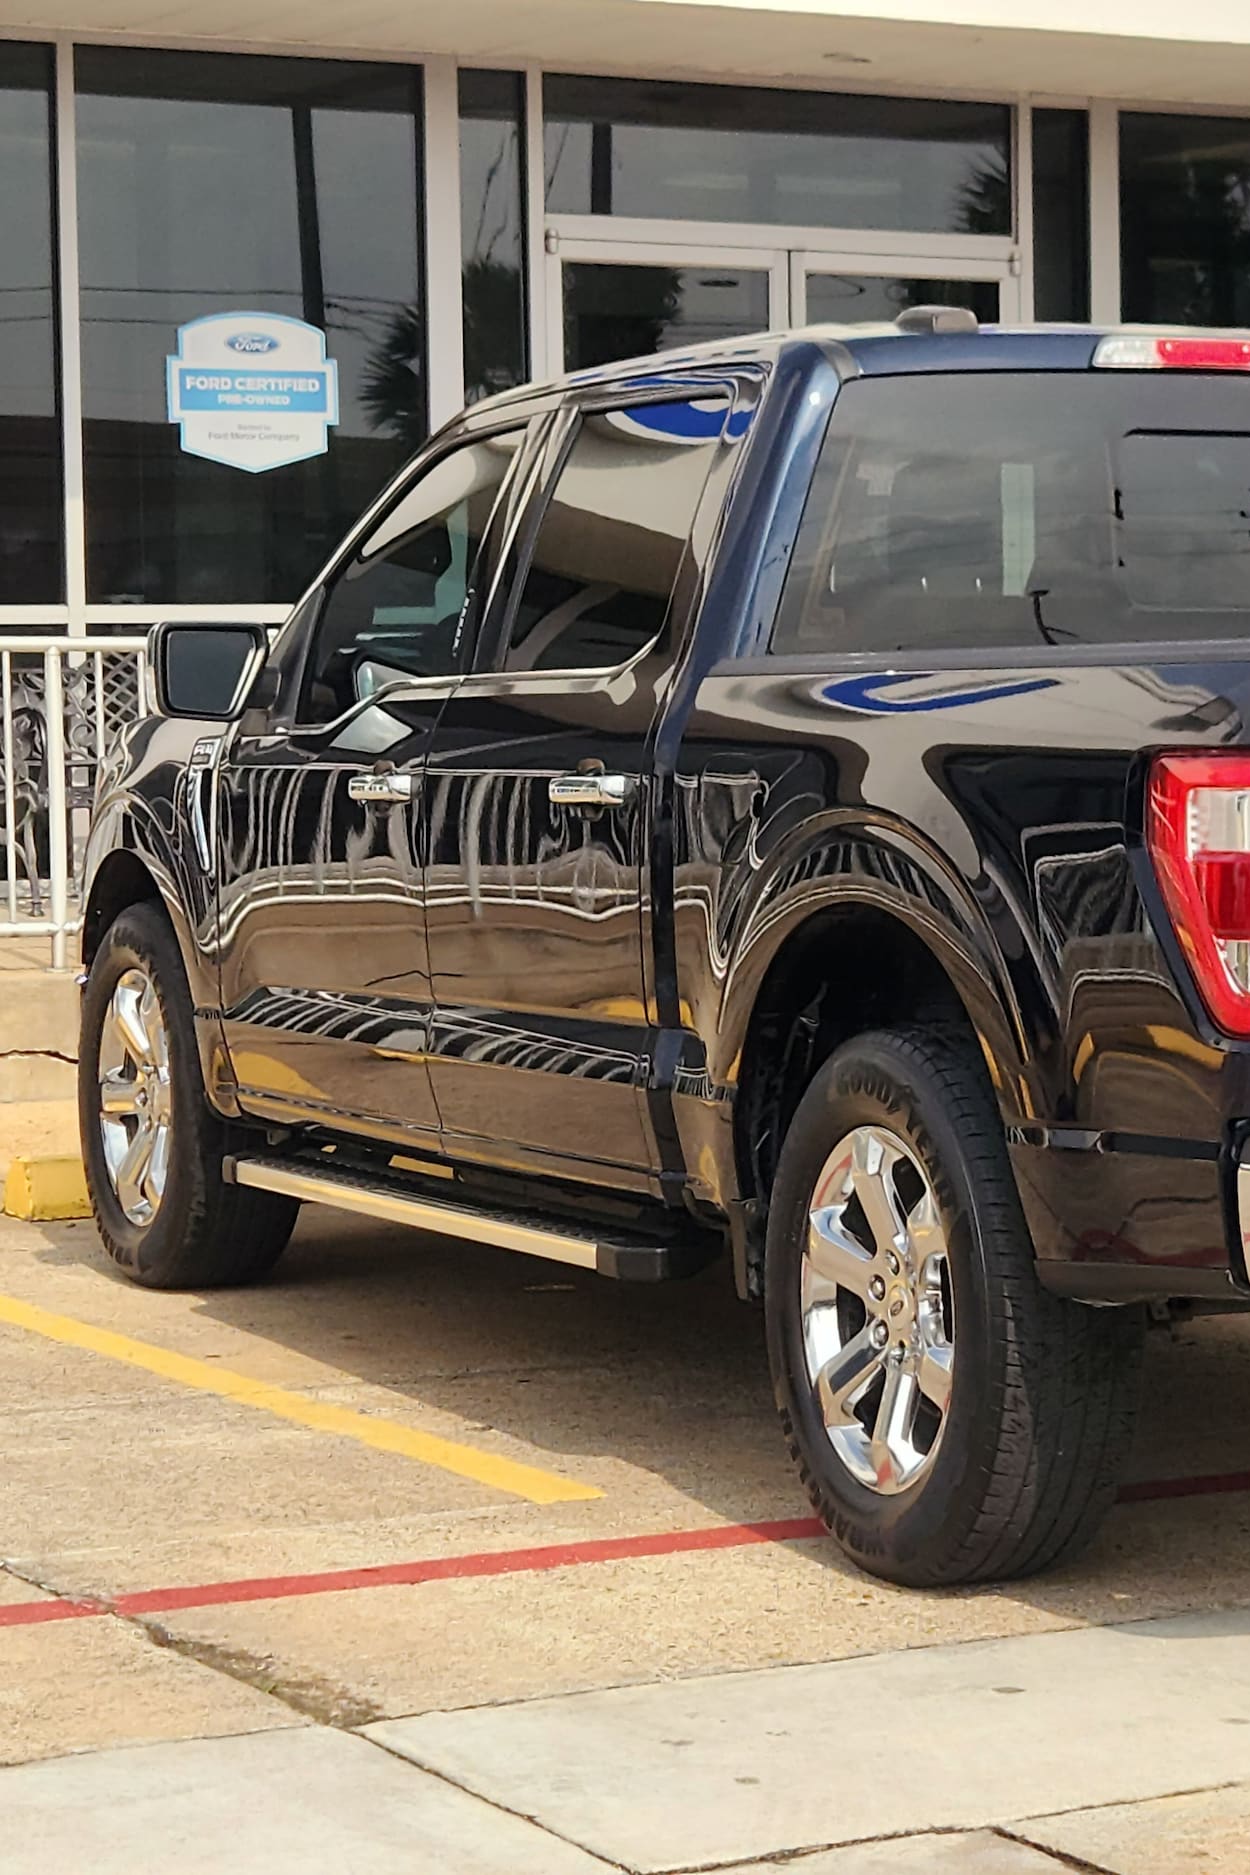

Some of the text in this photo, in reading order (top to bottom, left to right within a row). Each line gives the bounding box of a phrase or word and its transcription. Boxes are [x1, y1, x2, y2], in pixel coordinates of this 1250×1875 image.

[234, 335, 270, 352] Ford
[185, 376, 320, 392] FORD CERTIFIED
